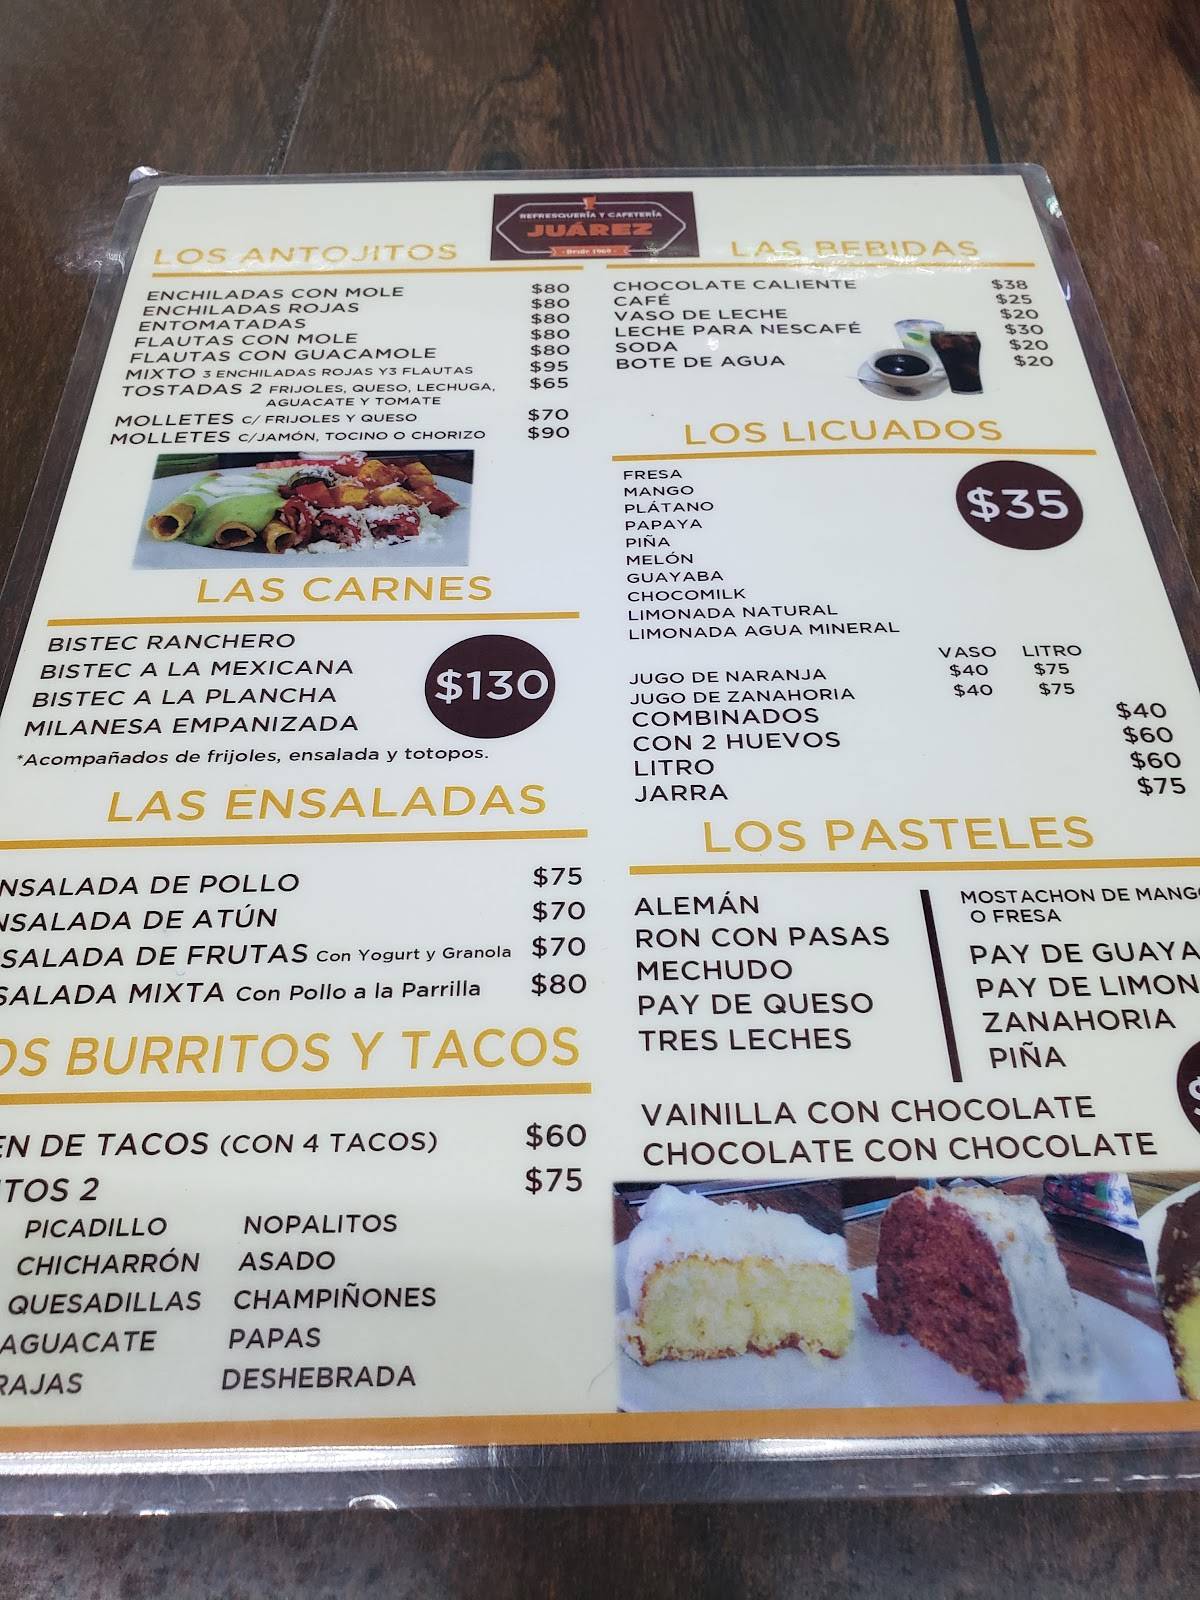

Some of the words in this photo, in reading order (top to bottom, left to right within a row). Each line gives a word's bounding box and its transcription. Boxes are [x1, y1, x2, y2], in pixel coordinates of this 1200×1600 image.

[519, 212, 597, 220] REFRESQUERÍA
[607, 210, 663, 218] CAFETERÍA
[527, 221, 654, 238] JUÁREZ
[153, 247, 227, 266] LOS
[240, 243, 458, 263] ANTOJITOS
[730, 240, 802, 258] LAS
[815, 239, 979, 258] BEBIDAS
[531, 282, 571, 295] $80
[613, 279, 747, 292] CHOCOLATE
[752, 279, 857, 290] CALIENTE
[991, 278, 1029, 291] $38
[146, 288, 284, 302] ENCHILADAS
[290, 287, 338, 299] CON
[344, 286, 405, 298] MOLE
[613, 292, 671, 307] CAFÉ
[995, 292, 1033, 306] $25
[142, 303, 281, 317] ENCHILADAS
[288, 302, 360, 314] ROJAS
[530, 297, 571, 311] $80
[613, 310, 675, 322] VASO
[682, 309, 712, 321] DE
[718, 308, 789, 320] LECHE
[999, 307, 1039, 321] $20
[138, 318, 307, 333] ENTOMATADAS
[614, 324, 686, 338] LECHE
[692, 323, 754, 336] PARA
[760, 320, 862, 335] NESCAFÉ
[1004, 322, 1045, 336] $30
[133, 334, 234, 349] FLAUTAS
[241, 333, 290, 346] CON
[296, 332, 359, 345] MOLE
[615, 340, 679, 354] SODA
[129, 350, 231, 365] FLAUTAS
[238, 349, 287, 362] CON
[294, 347, 437, 361] GUACAMOLE
[615, 356, 677, 370] BOTE
[683, 355, 713, 369] DE
[720, 354, 787, 368] AGUA
[124, 367, 196, 381] MIXTO
[202, 370, 212, 379] 3
[215, 368, 317, 379] ENCHILADAS
[321, 367, 374, 377] ROJAS
[402, 366, 474, 376] FLAUTAS
[529, 360, 569, 375] $95
[121, 382, 243, 398] TOSTADAS
[249, 382, 263, 395] 2
[268, 384, 347, 395] FRIJOLES,
[351, 383, 412, 394] QUESO,
[416, 382, 496, 393] LECHUGA,
[528, 376, 569, 391] $65
[265, 397, 356, 408] AGUACATE
[359, 397, 371, 406] Y
[374, 396, 442, 406] TOMATE
[114, 412, 235, 428] MOLLETES
[264, 414, 341, 425] FRIJOLES
[345, 413, 357, 424] Y
[360, 412, 418, 423] QUESO
[527, 407, 570, 423] $70
[109, 430, 231, 446] MOLLETES
[324, 431, 389, 441] TOCINO
[393, 431, 406, 441] O
[410, 430, 486, 440] CHORIZO
[527, 425, 570, 441] $90
[683, 421, 768, 446] LOS
[782, 419, 1003, 443] LICUADOS
[623, 469, 683, 481] FRESA
[623, 485, 695, 498] MANGO
[624, 499, 715, 515] PLÁTANO
[965, 486, 1070, 522] $35
[624, 518, 703, 532] PAPAYA
[625, 534, 672, 549] PIÑA
[626, 550, 694, 566] MELÓN
[626, 570, 724, 584] GUAYABA
[196, 577, 286, 605] LAS
[302, 575, 494, 604] CARNES
[627, 588, 747, 603] CHOCOMILK
[628, 607, 736, 622] LIMONADA
[742, 604, 839, 618] NATURAL
[628, 625, 738, 641] LIMONADA
[743, 624, 804, 638] AGUA
[808, 621, 901, 636] MINERAL
[47, 635, 139, 653] BISTEC
[146, 633, 296, 650] RANCHERO
[937, 645, 997, 659] VASO
[1021, 644, 1083, 658] LITRO
[39, 662, 133, 680] BISTEC
[139, 661, 159, 678] A
[167, 661, 201, 677] LA
[210, 659, 354, 677] MEXICANA
[628, 672, 685, 686] JUGO
[691, 670, 720, 684] DE
[725, 668, 828, 683] NARANJA
[949, 663, 989, 679] $40
[1033, 661, 1070, 677] $75
[433, 668, 550, 705] $130
[953, 683, 994, 699] $40
[1038, 681, 1076, 697] $75
[629, 692, 686, 706] JUGO
[693, 690, 721, 704] DE
[727, 687, 856, 703] ZANAHORIA
[631, 707, 820, 728] COMBINADOS
[1115, 700, 1168, 721] $40
[23, 717, 163, 737] MILANESA
[171, 715, 359, 734] EMPANIZADA
[632, 734, 692, 753] CON
[701, 734, 717, 751] 2
[726, 731, 841, 750] HUEVOS
[175, 749, 201, 764] de
[207, 748, 281, 766] frijoles,
[288, 747, 380, 762] ensalada
[385, 750, 399, 763] y
[403, 747, 489, 763] totopos.
[634, 758, 715, 777] LITRO
[634, 783, 729, 803] JARRA
[106, 788, 208, 823] LAS
[225, 783, 547, 821] ENSALADAS
[703, 818, 807, 854] LOS
[823, 815, 1095, 852] PASTELES
[532, 865, 583, 889] $75
[633, 890, 760, 917] ALEMÁN
[135, 945, 178, 967] DE
[186, 943, 309, 966] FRUTAS
[316, 949, 352, 963] Con
[357, 947, 421, 964] Yogurt
[425, 949, 437, 963] y
[442, 944, 512, 960] Granola
[636, 958, 793, 982] MECHUDO
[981, 1007, 1177, 1034] ZANAHORIA
[637, 1028, 719, 1052] TRES
[728, 1027, 852, 1051] LECHES
[988, 1040, 1068, 1069] PIÑA
[640, 1101, 798, 1127] VAINILLA
[807, 1099, 880, 1125] CON
[890, 1095, 1097, 1123] CHOCOLATE
[525, 1121, 587, 1151] $60
[24, 1216, 168, 1240] PICADILLO
[243, 1213, 398, 1235] NOPALITOS
[16, 1246, 201, 1277] CHICHARRÓN
[237, 1250, 336, 1272] ASADO
[7, 1290, 202, 1316] QUESADILLAS
[233, 1281, 437, 1311] CHAMPIÑONES
[0, 1329, 158, 1356] AGUACATE
[228, 1326, 321, 1350] PAPAS
[220, 1364, 417, 1391] DESHEBRADA
